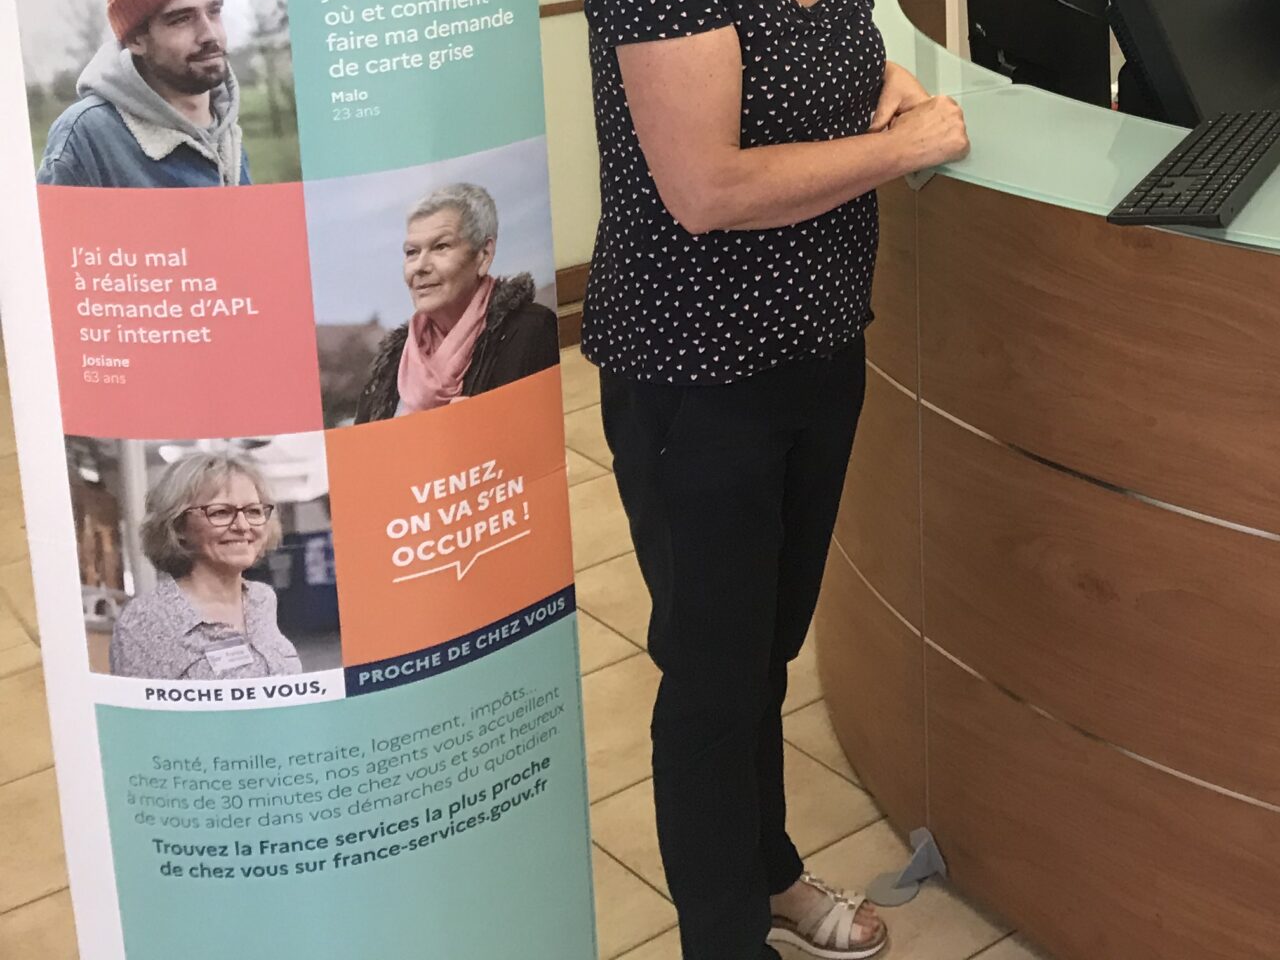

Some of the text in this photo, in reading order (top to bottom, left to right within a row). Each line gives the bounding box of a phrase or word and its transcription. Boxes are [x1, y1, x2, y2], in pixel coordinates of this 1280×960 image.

[324, 5, 354, 26] où
[361, 6, 385, 22] et
[326, 8, 514, 52] faire ma demande
[329, 43, 474, 78] de carte grise
[331, 89, 368, 103] Malo
[332, 106, 381, 121] 23 ans
[71, 247, 188, 268] J'ai du mal
[75, 272, 217, 292] à réaliser ma
[77, 297, 259, 318] demande d'APL
[80, 324, 212, 343] sur internet
[82, 354, 130, 368] Josiane
[83, 371, 126, 384] 63 ans
[411, 459, 504, 503] VENEZ,
[386, 476, 524, 539] ON VA S'EN
[391, 501, 530, 567] OCCUPER !
[358, 596, 566, 686] PROCHE DE CHEZ VOUS
[145, 680, 328, 702] PROCHE DE VOUS,
[127, 704, 565, 810] à moins de 30 minutes de chez vous et sont heureux
[129, 687, 560, 791] chez France services, nos agents vous accueillent
[152, 755, 207, 774] Santé,
[213, 754, 282, 772] famille,
[288, 746, 365, 767] retraite,
[372, 715, 465, 753] logement,
[134, 811, 155, 826] de
[160, 816, 200, 829] vous
[206, 813, 251, 829] aider
[257, 810, 303, 827] dans
[309, 807, 341, 821] vos
[348, 777, 452, 816] démarches
[457, 763, 479, 783] du
[152, 757, 551, 857] Trouvez la France services la plus proche
[160, 778, 549, 879] de chez vous sur france-services.gouv.fr
